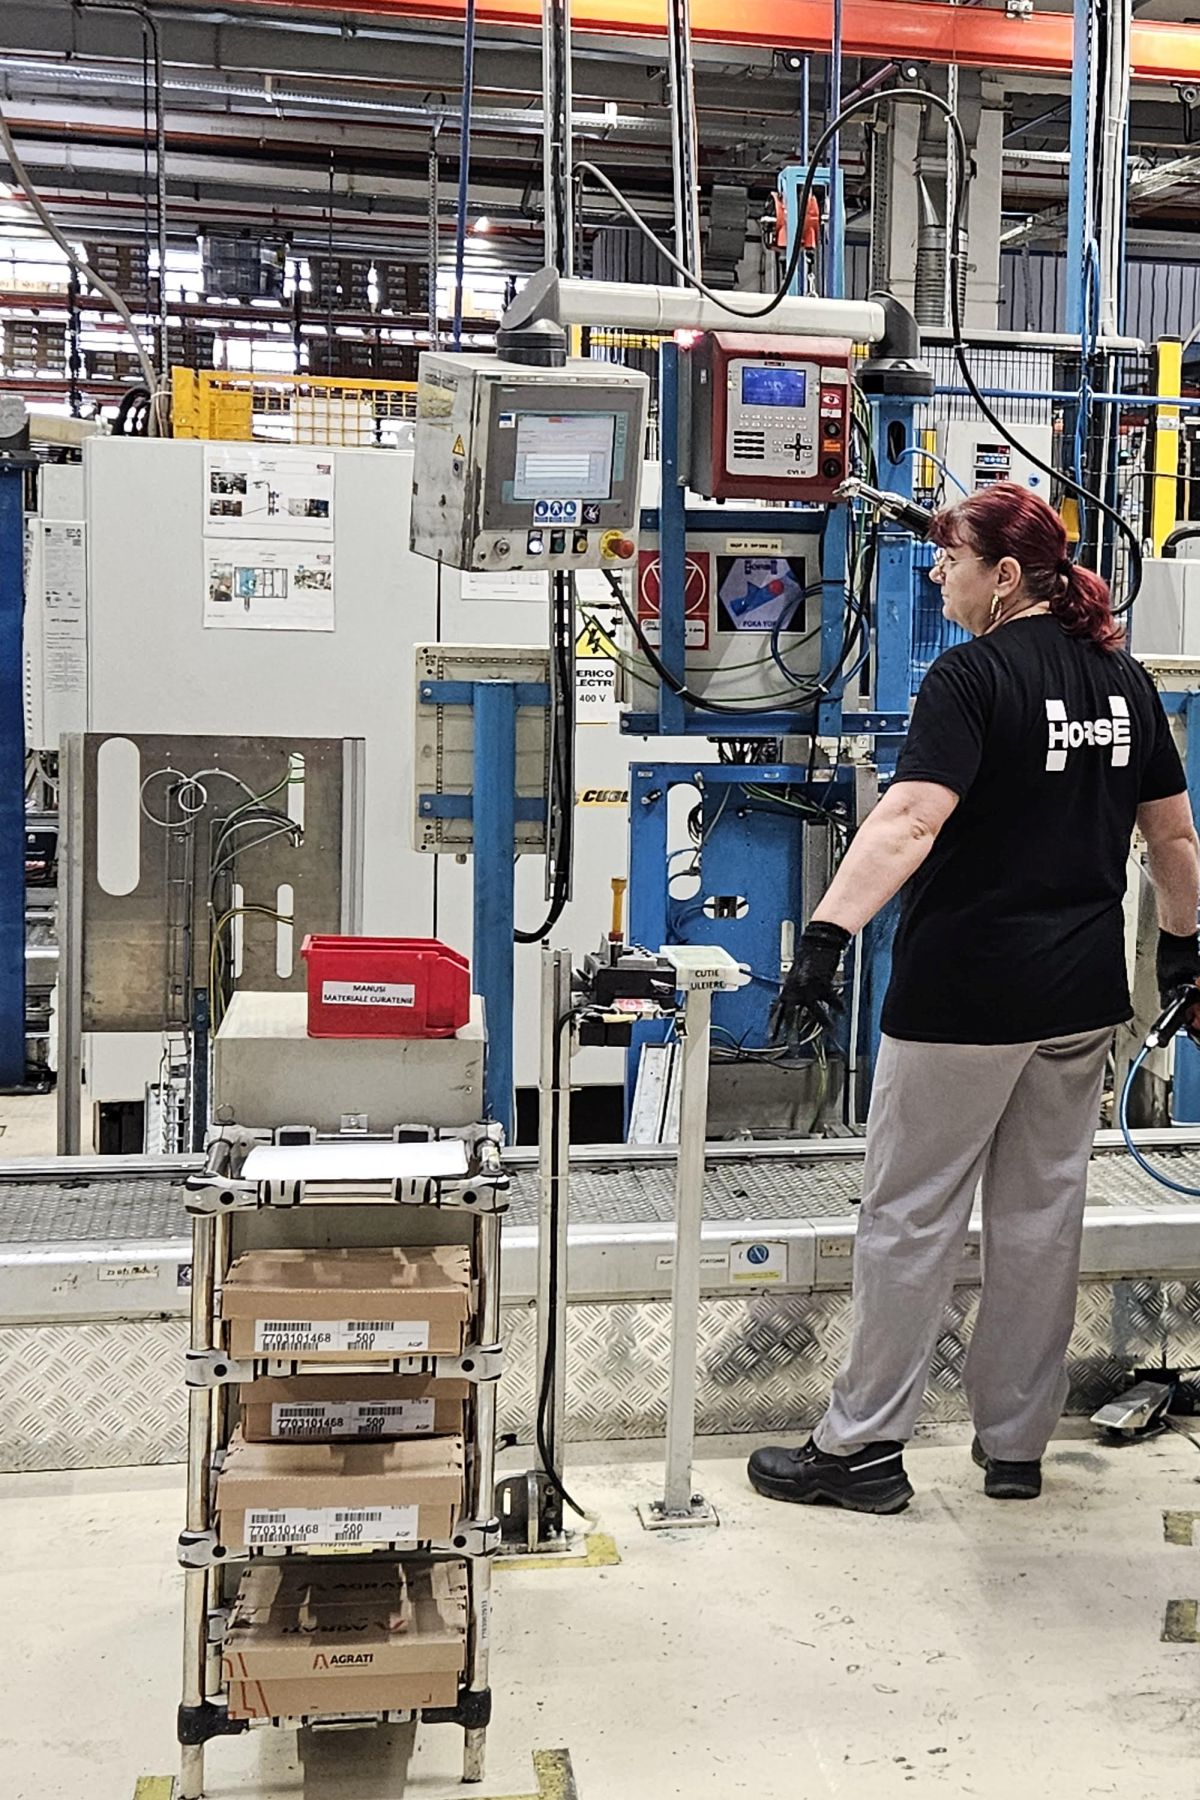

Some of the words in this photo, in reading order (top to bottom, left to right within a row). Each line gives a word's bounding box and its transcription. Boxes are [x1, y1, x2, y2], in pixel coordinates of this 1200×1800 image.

[576, 670, 614, 678] ERICO
[579, 694, 597, 702] 400
[599, 694, 607, 702] V
[695, 969, 719, 978] CUTIE
[324, 994, 368, 1003] MATERIALE
[370, 996, 413, 1004] CURATENIE
[261, 1333, 331, 1343] 7703101468
[356, 1332, 376, 1343] 500
[276, 1417, 344, 1429] 7703101468
[366, 1417, 385, 1427] 500
[249, 1524, 319, 1535] 7703101468
[343, 1523, 363, 1534] 500
[330, 1653, 374, 1665] AGRATI
